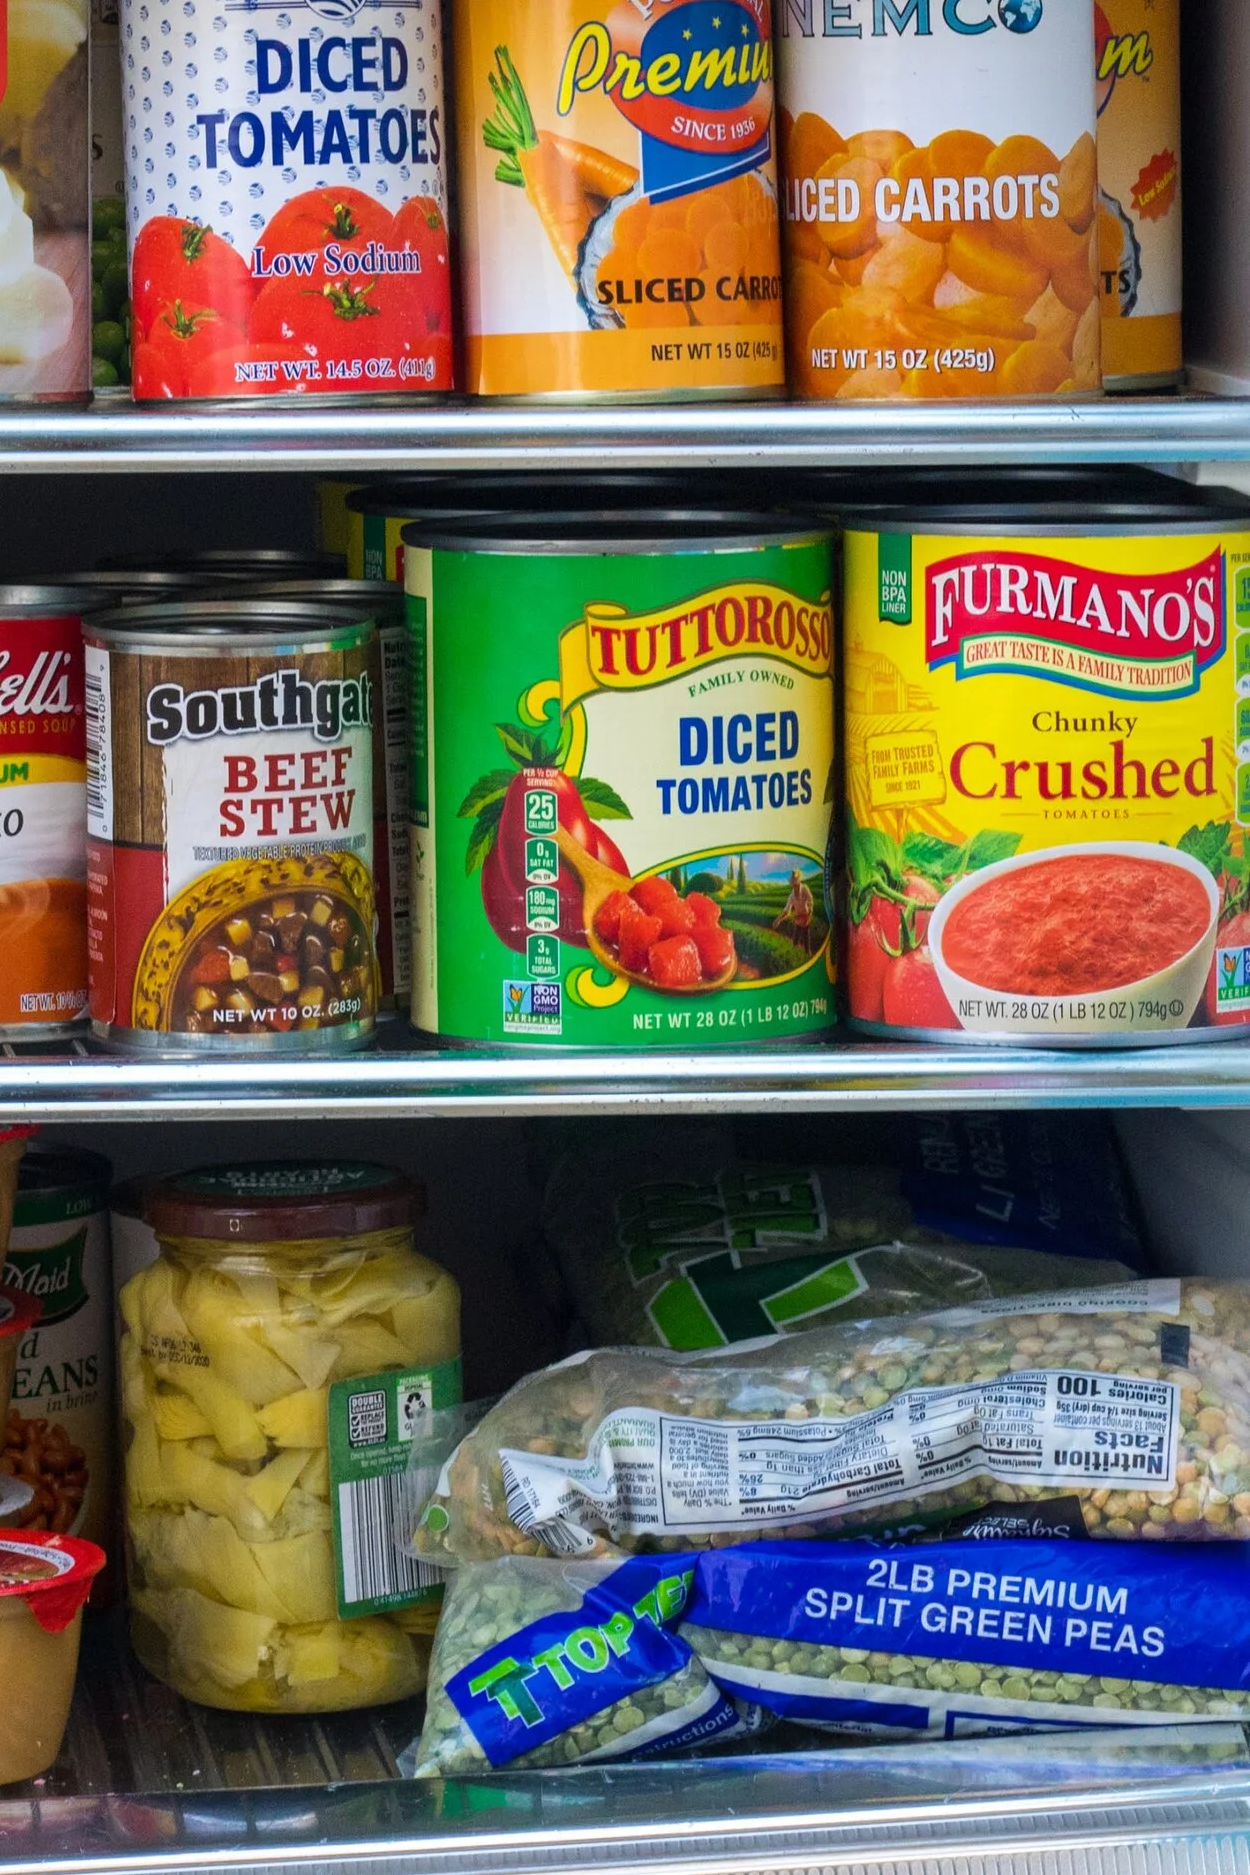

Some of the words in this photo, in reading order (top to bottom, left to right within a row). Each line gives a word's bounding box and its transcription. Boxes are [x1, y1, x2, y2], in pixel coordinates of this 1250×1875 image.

[256, 37, 408, 94] DICED
[196, 109, 440, 169] TOMATOES
[671, 116, 726, 140] SINCE
[730, 117, 756, 139] 1936
[778, 178, 860, 223] LICED
[875, 174, 1060, 224] CARROTS
[253, 246, 318, 277] Low
[324, 242, 420, 274] Sodium
[599, 277, 705, 304] SLICED
[882, 570, 906, 588] NON
[882, 586, 906, 602] BPA
[882, 601, 906, 614] LINER
[932, 563, 1215, 648] FURMANO'S
[591, 595, 832, 677] TUTTOROSSO
[688, 671, 744, 698] FAMILY
[749, 671, 794, 690] OWNED
[966, 643, 1007, 664] GREAT
[1009, 646, 1051, 666] TASTE
[1053, 649, 1063, 666] IS
[1066, 653, 1075, 669] A
[1078, 657, 1125, 681] FAMILY
[1127, 661, 1191, 685] TRADITION
[679, 710, 798, 766] DICED
[1033, 710, 1137, 735] Chunky
[224, 747, 352, 793] BEEF
[949, 736, 1217, 800] Crushed
[528, 795, 553, 821] 25
[656, 769, 812, 815] TOMATOES
[219, 790, 355, 838] STEW
[1044, 808, 1129, 819] TOMATOES
[1058, 1376, 1100, 1395] 100
[1054, 1446, 1163, 1474] Nutrition
[1094, 1430, 1163, 1450] Facts
[865, 1558, 935, 1594] 2LB
[948, 1568, 1128, 1615] PREMIUM
[805, 1586, 909, 1628] SPLIT
[921, 1601, 1053, 1645] GREEN
[1064, 1618, 1165, 1657] PEAS
[531, 1611, 636, 1691] TOP
